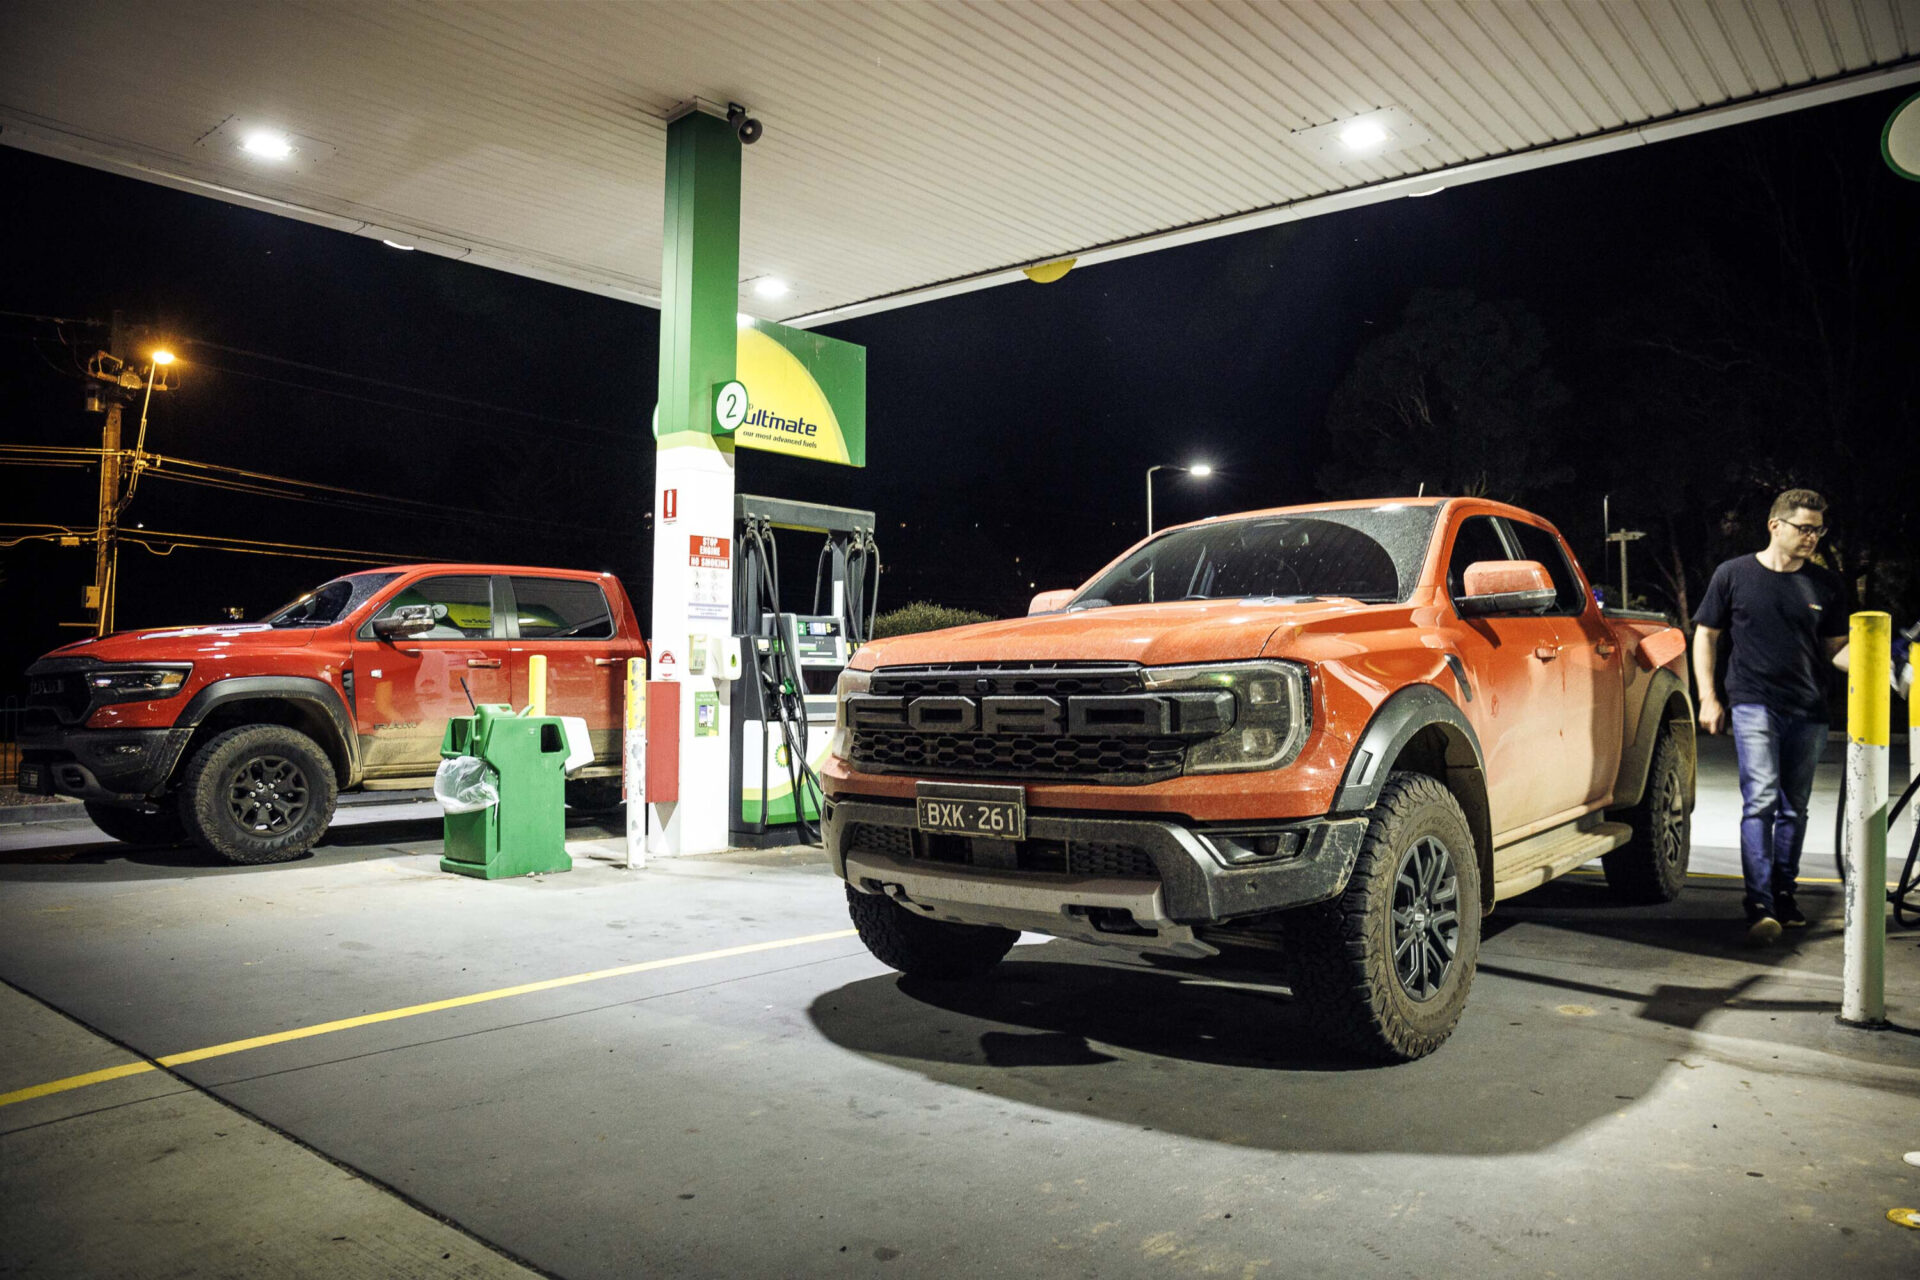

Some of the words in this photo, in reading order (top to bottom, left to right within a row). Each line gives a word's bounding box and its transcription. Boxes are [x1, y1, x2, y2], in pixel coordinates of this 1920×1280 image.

[726, 393, 737, 419] 2
[743, 408, 818, 437] ultimate
[743, 429, 755, 438] our
[755, 431, 772, 441] most
[773, 434, 802, 446] advanced
[803, 438, 817, 449] fuels
[702, 536, 718, 547] STOP
[691, 556, 700, 567] NO
[701, 557, 729, 569] SMOKING
[374, 720, 417, 731] RAM
[848, 696, 1172, 735] FORD
